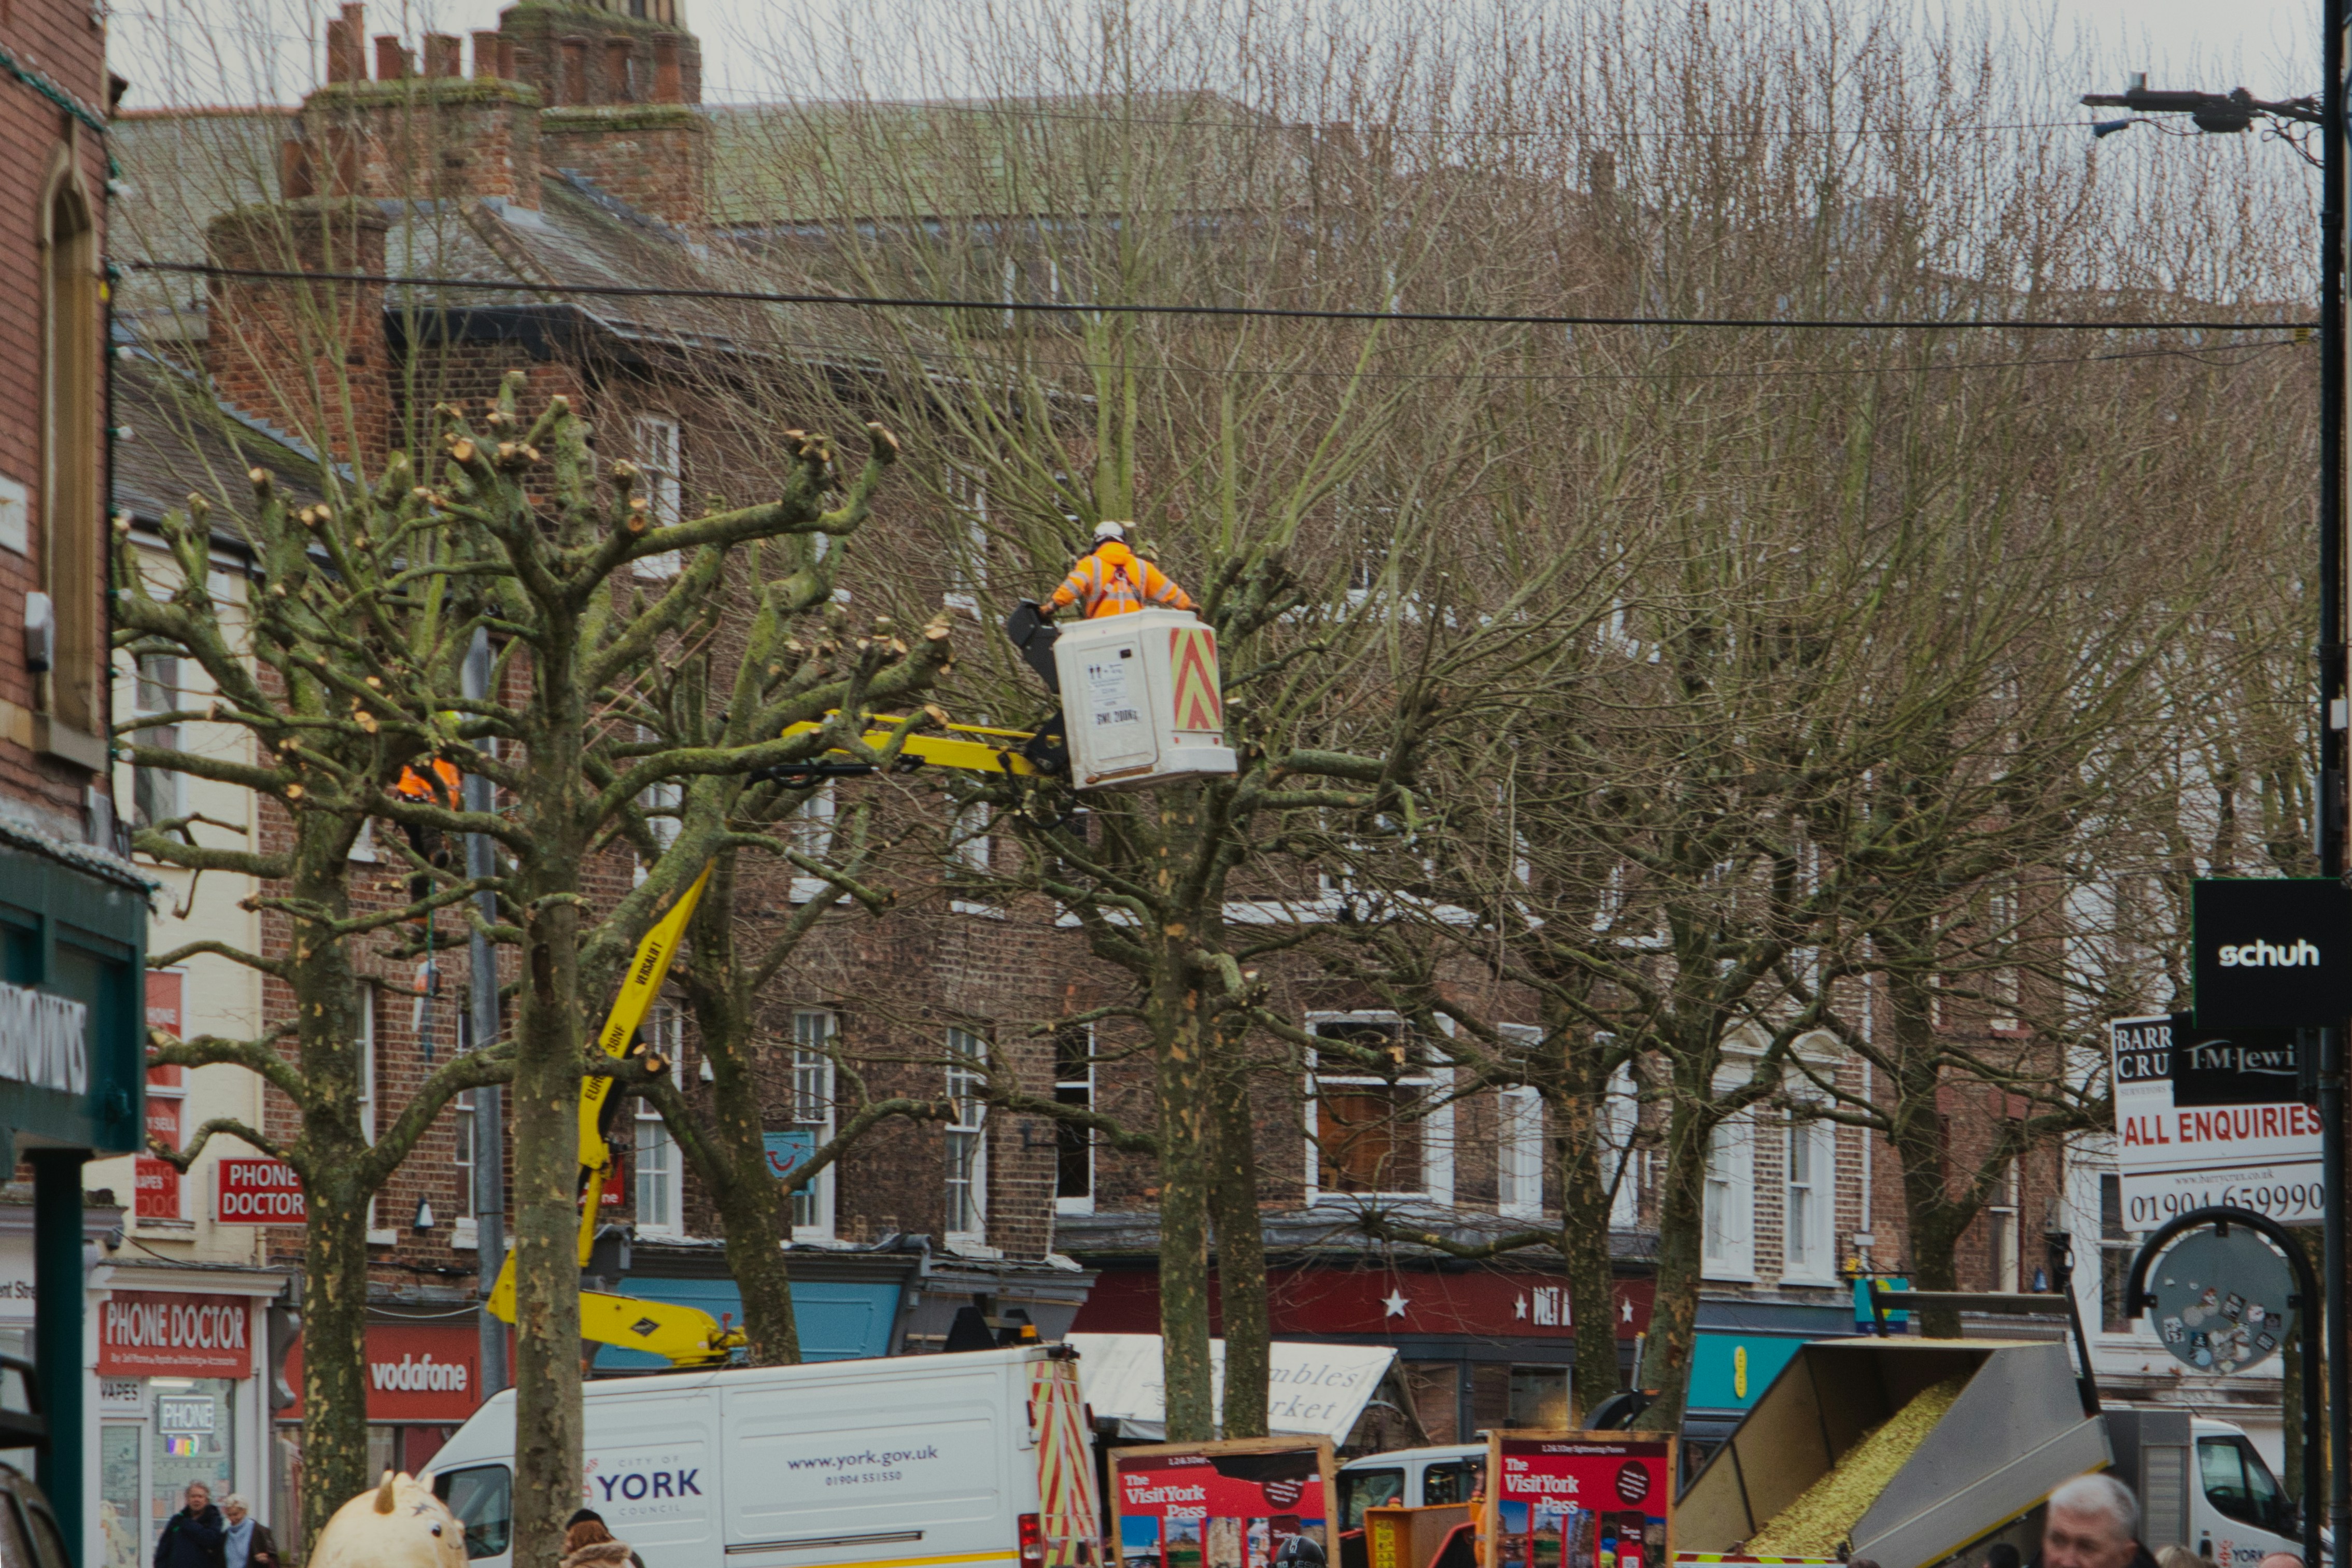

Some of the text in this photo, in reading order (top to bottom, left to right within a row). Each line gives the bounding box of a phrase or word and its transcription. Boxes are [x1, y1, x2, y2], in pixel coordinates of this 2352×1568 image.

[636, 941, 663, 985] VERSALIFT
[2219, 938, 2320, 967] schuh
[606, 1023, 625, 1052] 38NF
[2124, 1105, 2323, 1146] ALL ENQUIRIES
[230, 1164, 299, 1186] PHONE
[223, 1193, 305, 1215] DOCTOR
[106, 1302, 245, 1349] PHONE DOCTOR
[371, 1353, 467, 1391] vodafone
[101, 1383, 137, 1401] VAPES
[164, 1403, 214, 1428] PHONE
[618, 1455, 679, 1467] CITY OF
[787, 1445, 937, 1471] www.york.gov.uk
[1505, 1458, 1529, 1471] The
[596, 1468, 702, 1502] YORK
[825, 1476, 859, 1486] 01904
[1124, 1474, 1150, 1487] The
[618, 1504, 680, 1516] COUNCIL
[1166, 1504, 1207, 1519] Pass
[1541, 1496, 1579, 1515] Pass
